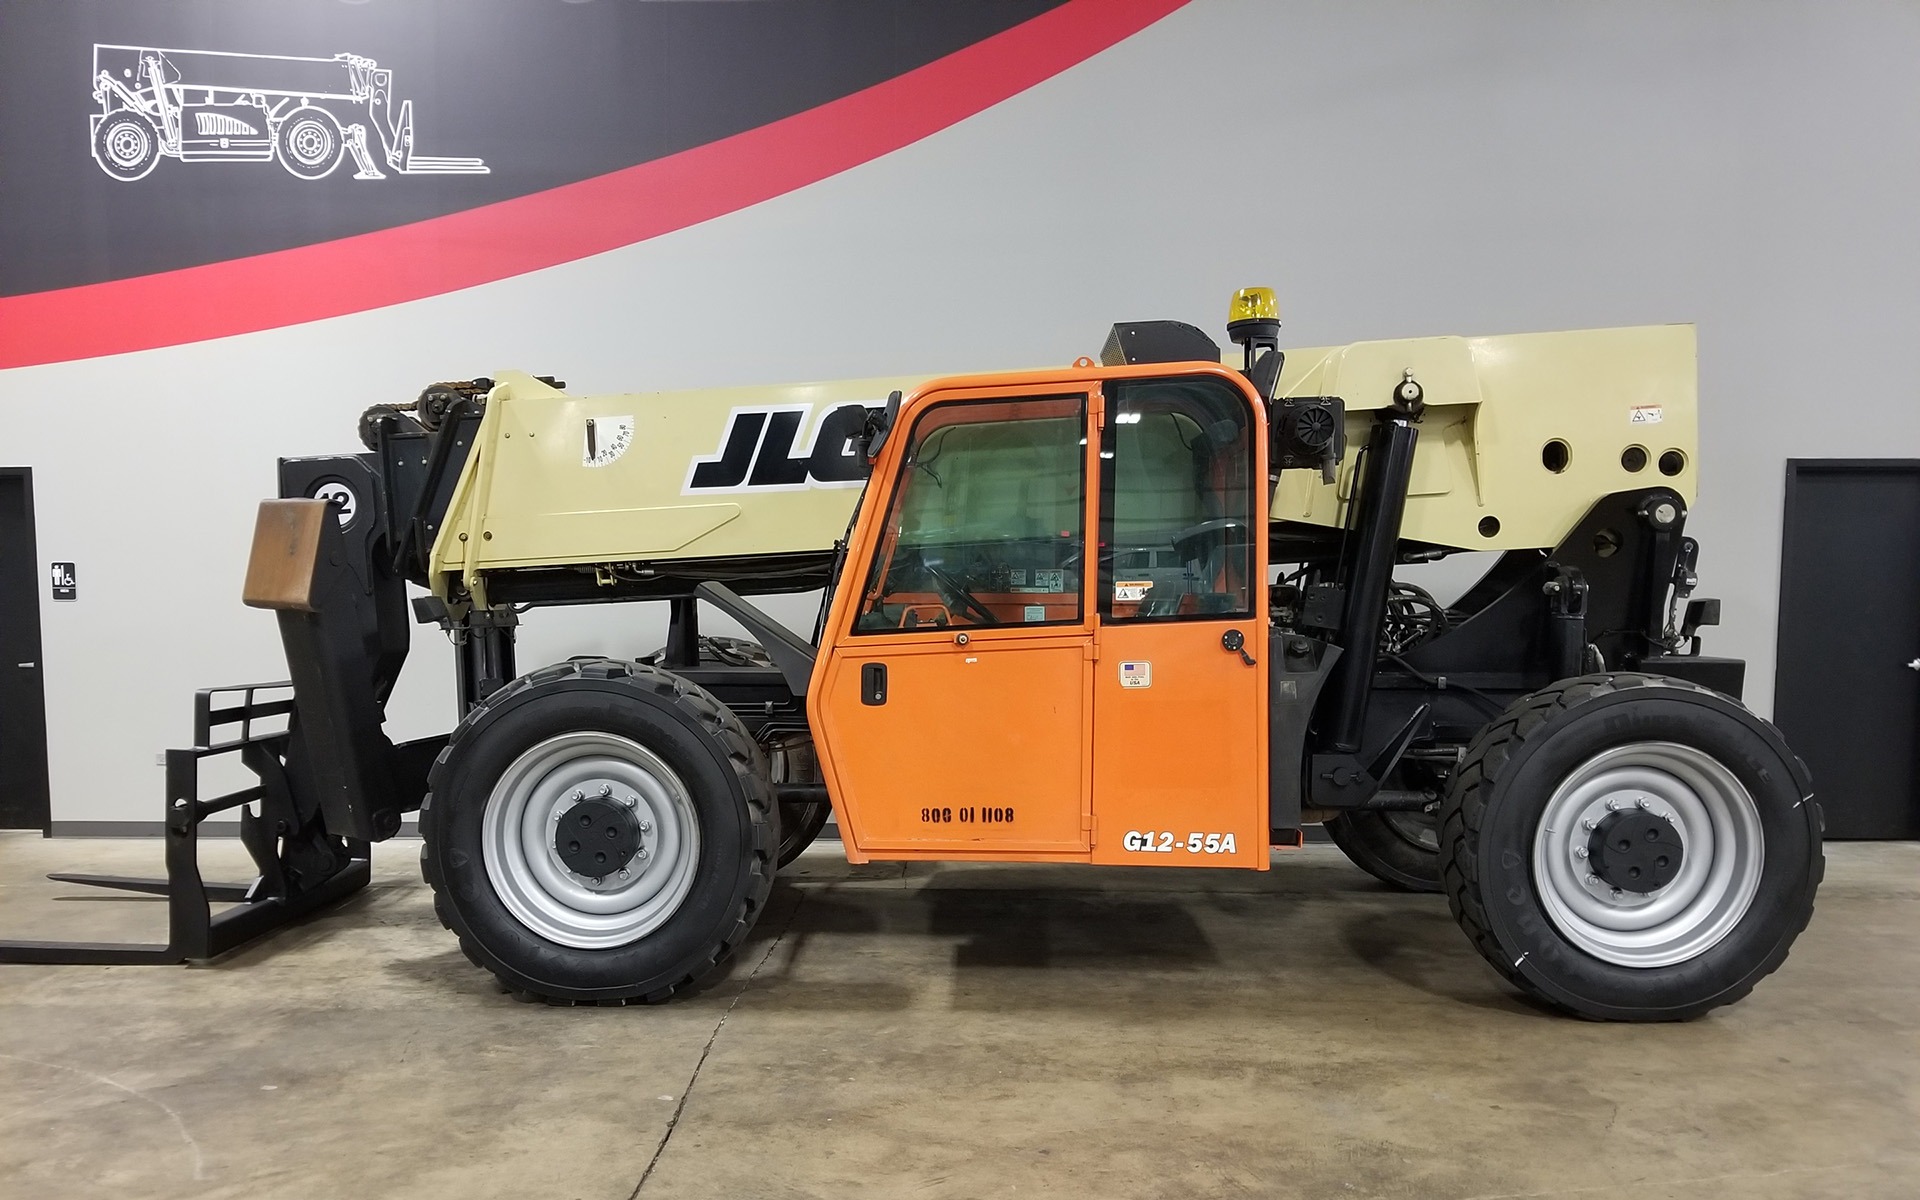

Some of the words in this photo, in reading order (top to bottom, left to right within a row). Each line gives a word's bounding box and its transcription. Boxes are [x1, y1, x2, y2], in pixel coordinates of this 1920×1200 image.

[686, 404, 887, 490] JLG
[982, 807, 1014, 823] 1108
[1123, 830, 1237, 854] G12-55A
